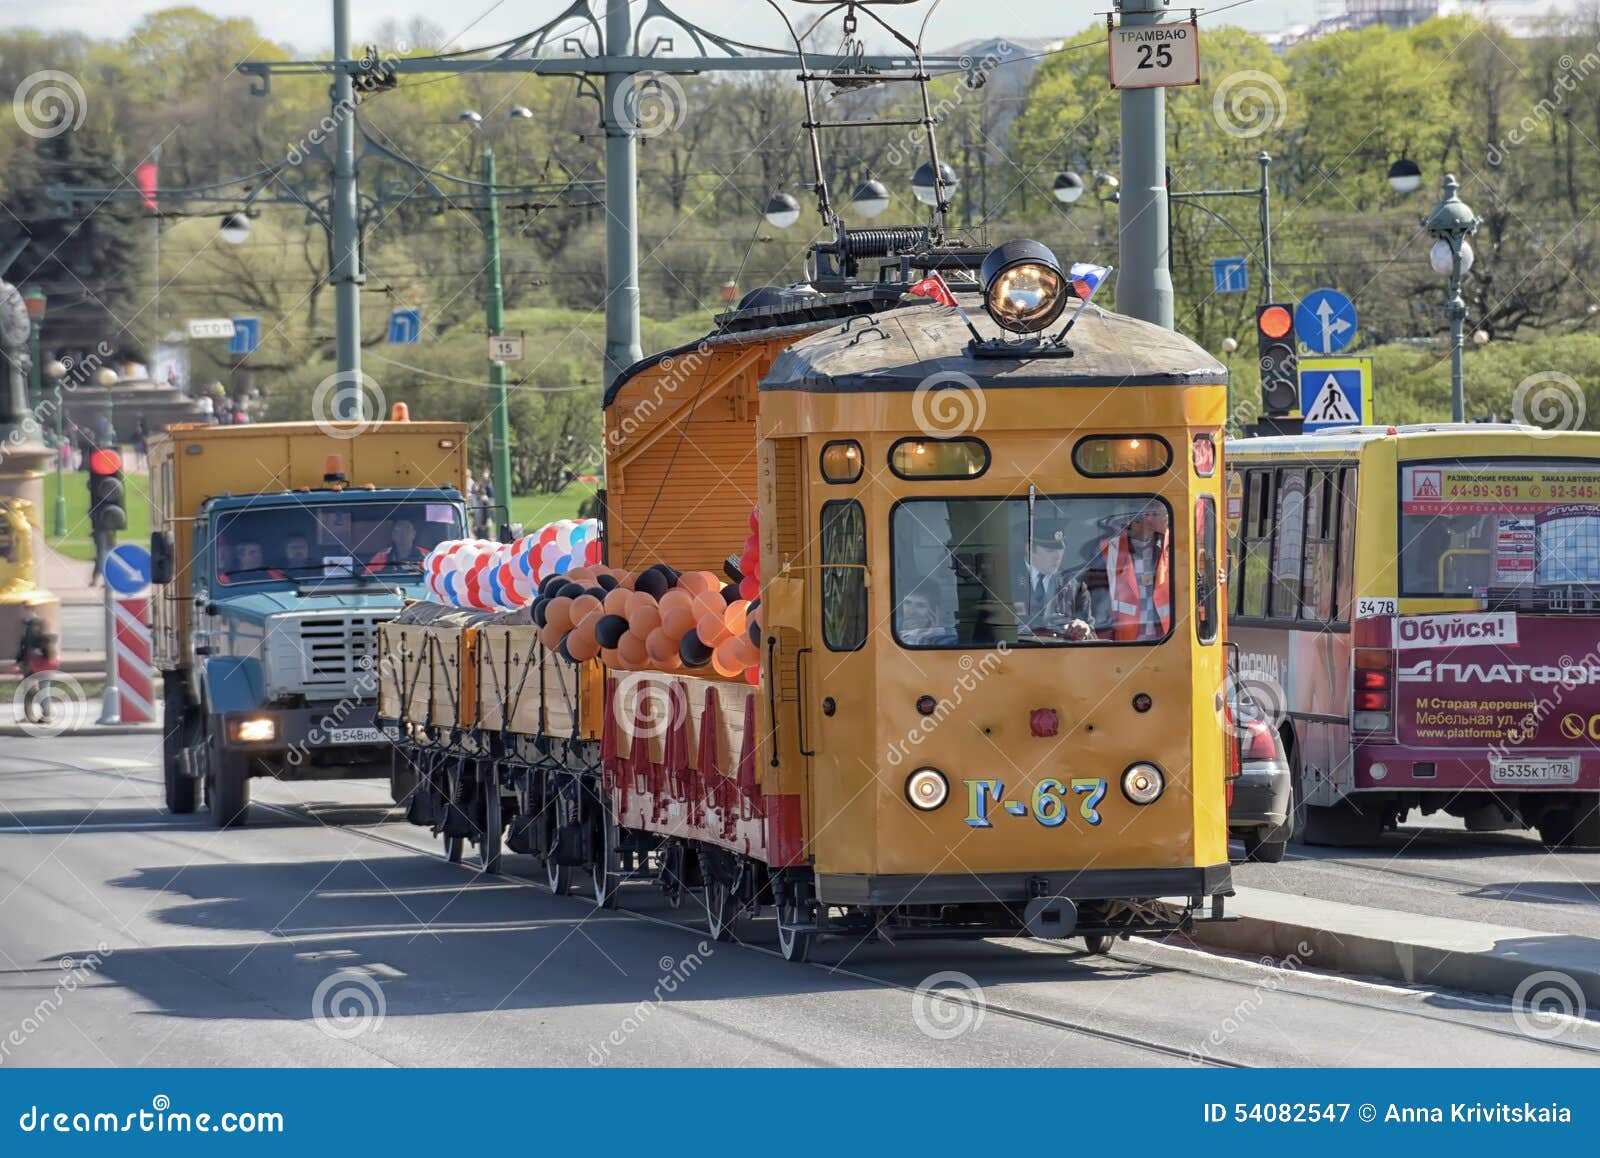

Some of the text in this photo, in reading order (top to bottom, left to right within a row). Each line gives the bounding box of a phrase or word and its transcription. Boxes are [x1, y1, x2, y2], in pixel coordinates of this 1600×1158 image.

[1120, 29, 1187, 42] ТРАМВАЮ
[1137, 43, 1173, 69] 25
[499, 343, 513, 354] 15
[1541, 475, 1565, 483] ЗАКАЗ
[1550, 485, 1600, 498] 92-545-
[1400, 618, 1505, 644] Обуйся!
[1431, 698, 1477, 710] Старая
[1480, 700, 1534, 711] деревня
[1416, 712, 1493, 725] Мебельная
[1499, 764, 1569, 777] В535КТ 178
[963, 777, 1108, 827] Г-67
